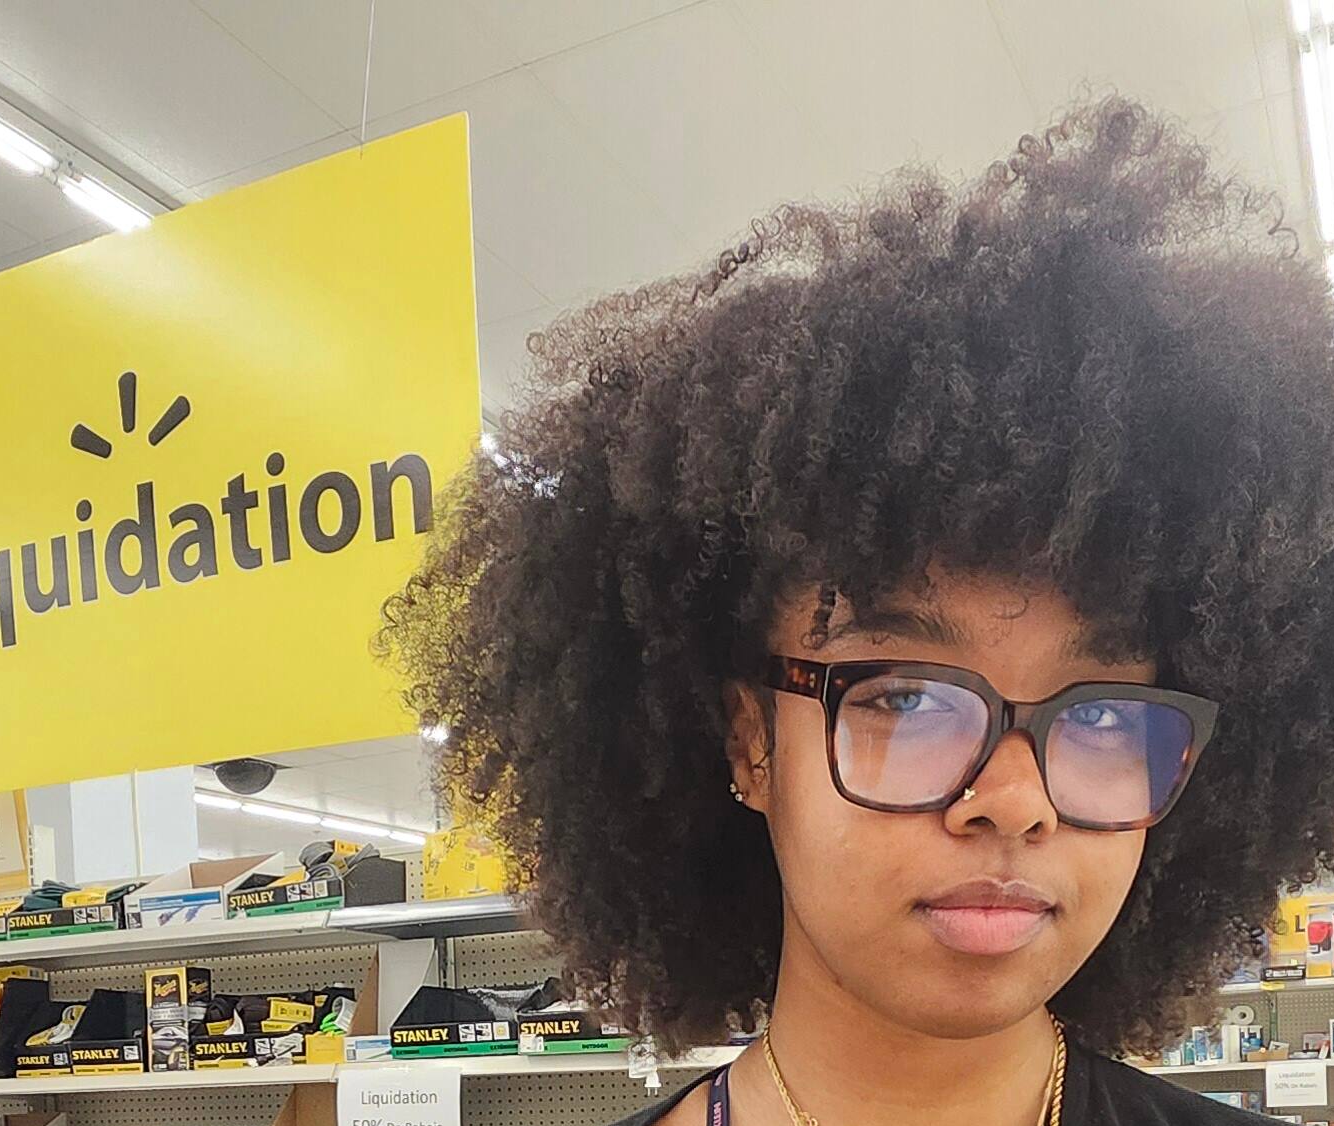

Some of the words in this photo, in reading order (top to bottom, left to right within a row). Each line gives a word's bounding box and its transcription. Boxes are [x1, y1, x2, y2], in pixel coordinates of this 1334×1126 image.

[229, 891, 274, 907] STANLEY
[9, 914, 53, 930] STANLEY
[393, 1028, 449, 1043] STANLEY
[519, 1020, 580, 1036] STANLEY
[72, 1049, 119, 1060] STANLEY
[195, 1042, 248, 1055] STANLEY
[17, 1055, 50, 1065] STANLEY
[361, 1090, 438, 1108] Liquidation
